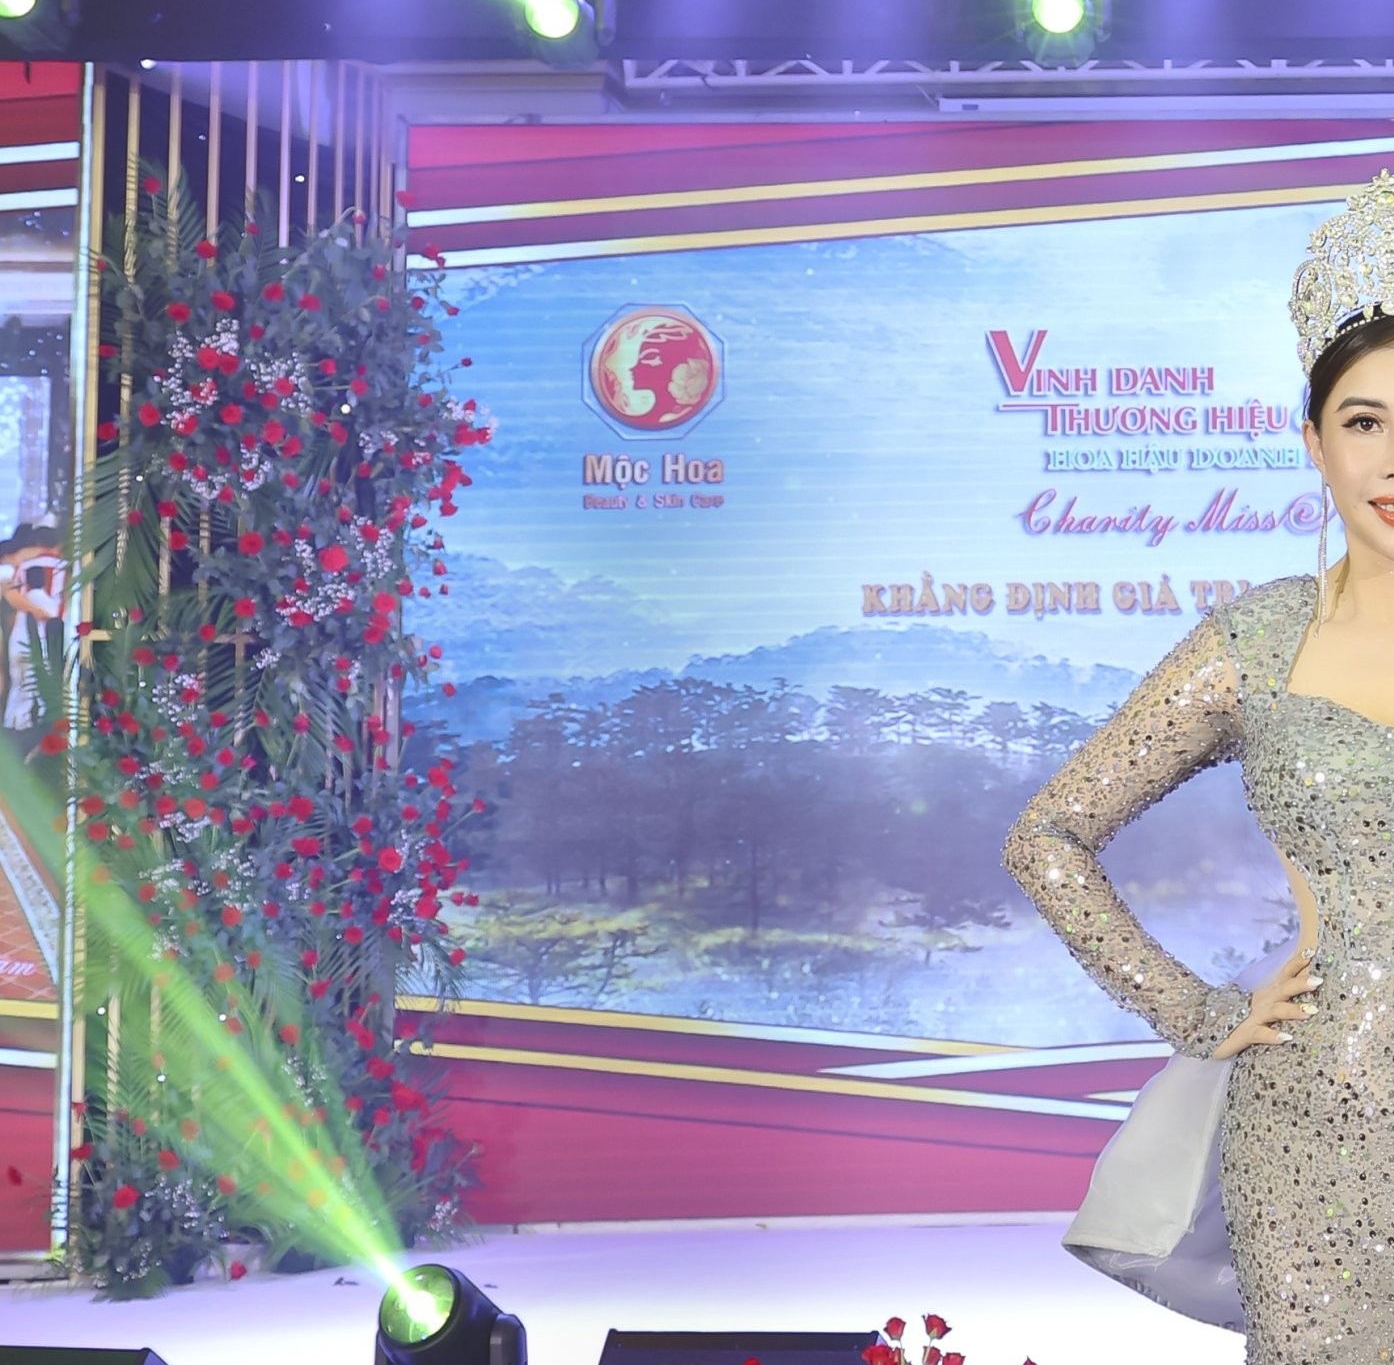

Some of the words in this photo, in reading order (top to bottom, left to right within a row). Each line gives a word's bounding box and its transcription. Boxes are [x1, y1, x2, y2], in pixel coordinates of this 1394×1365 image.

[985, 328, 1098, 396] VINH
[1112, 365, 1216, 395] DANH
[1000, 401, 1199, 434] THƯƠNG
[1207, 398, 1289, 441] HIỆU
[584, 453, 649, 491] Mộc
[662, 453, 724, 485] Hoa
[1046, 446, 1115, 471] HOA
[1121, 443, 1184, 475] HẬU
[1190, 445, 1303, 470] DOANH
[1014, 488, 1179, 547] Charity
